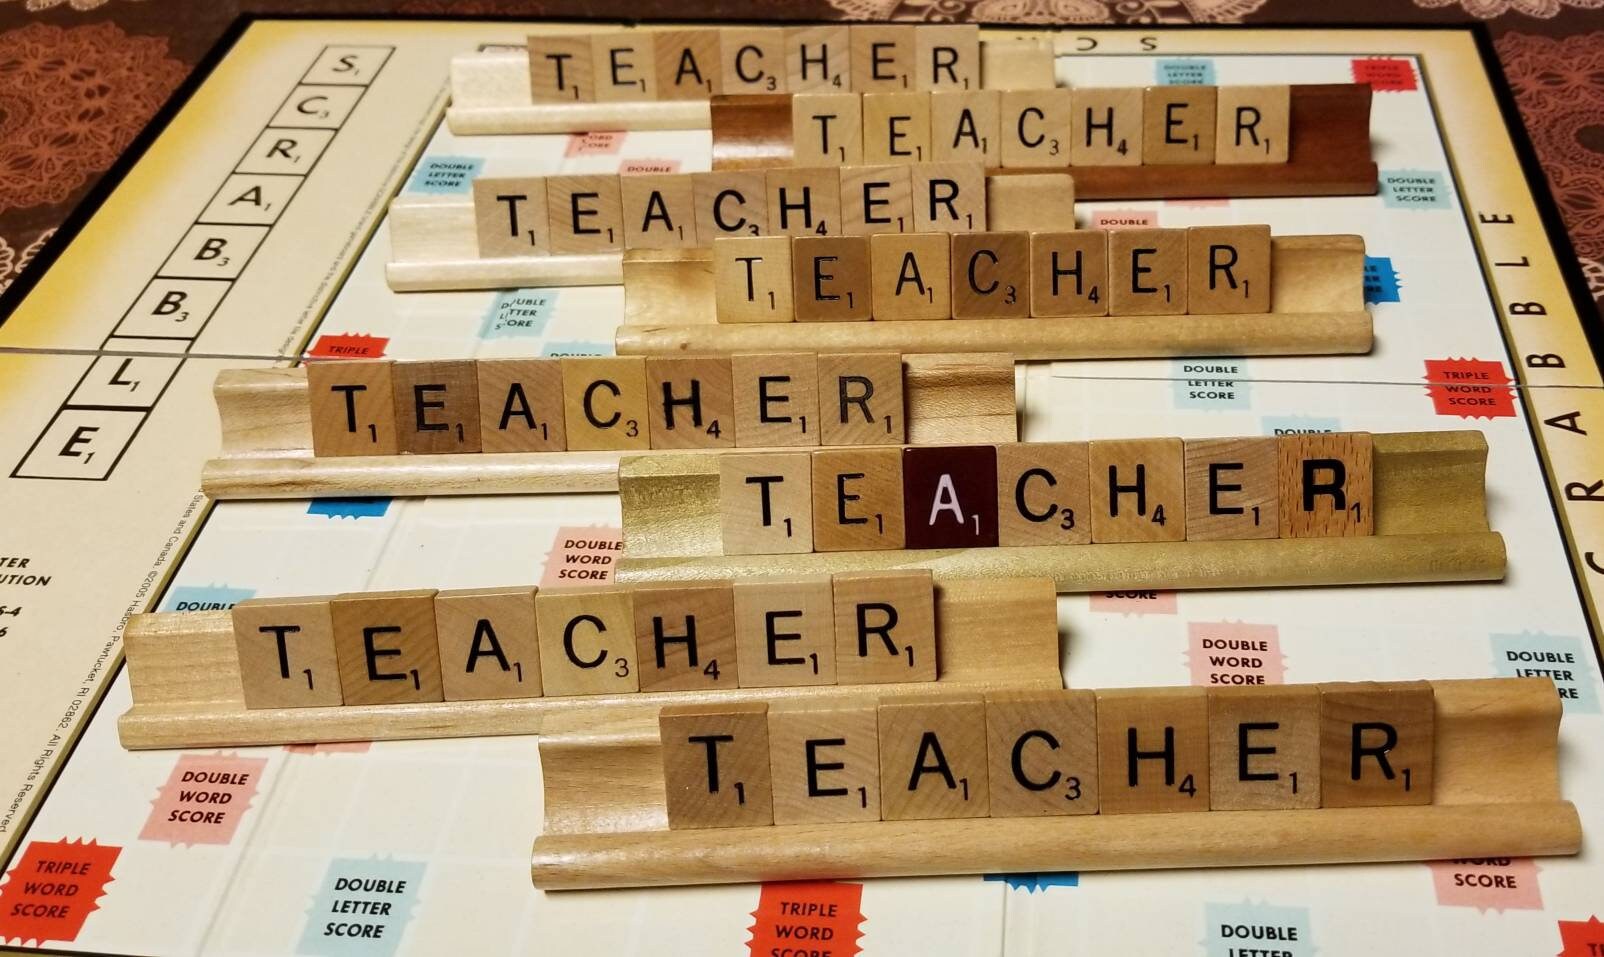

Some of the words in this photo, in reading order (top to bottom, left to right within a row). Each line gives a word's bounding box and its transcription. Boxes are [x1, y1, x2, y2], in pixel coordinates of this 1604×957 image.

[1387, 177, 1436, 185] DOUBLE
[1100, 218, 1149, 226] DOUBLE
[329, 346, 369, 355] TRIPLE
[1184, 365, 1239, 374] DOUBLE
[1443, 371, 1489, 380] TRIPLE
[1188, 380, 1235, 388] LETTER
[1446, 385, 1492, 394] WORD
[1189, 391, 1235, 400] SCORE
[1448, 397, 1497, 406] SCORE
[564, 538, 624, 551] DOUBLE
[565, 555, 612, 565] WORD
[558, 569, 608, 580] SCORE
[1202, 639, 1268, 652] DOUBLE
[1209, 656, 1263, 669] WORD
[1506, 651, 1575, 664] DOUBLE
[1210, 673, 1265, 686] SCORE
[77, 687, 90, 697] RI
[47, 734, 61, 747] All
[27, 749, 54, 781] Rights
[181, 771, 249, 785] DOUBLE
[179, 790, 232, 805] WORD
[168, 810, 226, 825] SCORE
[36, 860, 91, 876] TRIPLE
[334, 877, 407, 894] DOUBLE
[1454, 873, 1517, 888] SCORE
[24, 882, 79, 897] WORD
[11, 903, 70, 919] SCORE
[331, 899, 392, 915] LETTER
[781, 902, 838, 917] TRIPLE
[324, 922, 384, 939] SCORE
[776, 925, 833, 941] WORD
[1221, 924, 1298, 941] DOUBLE
